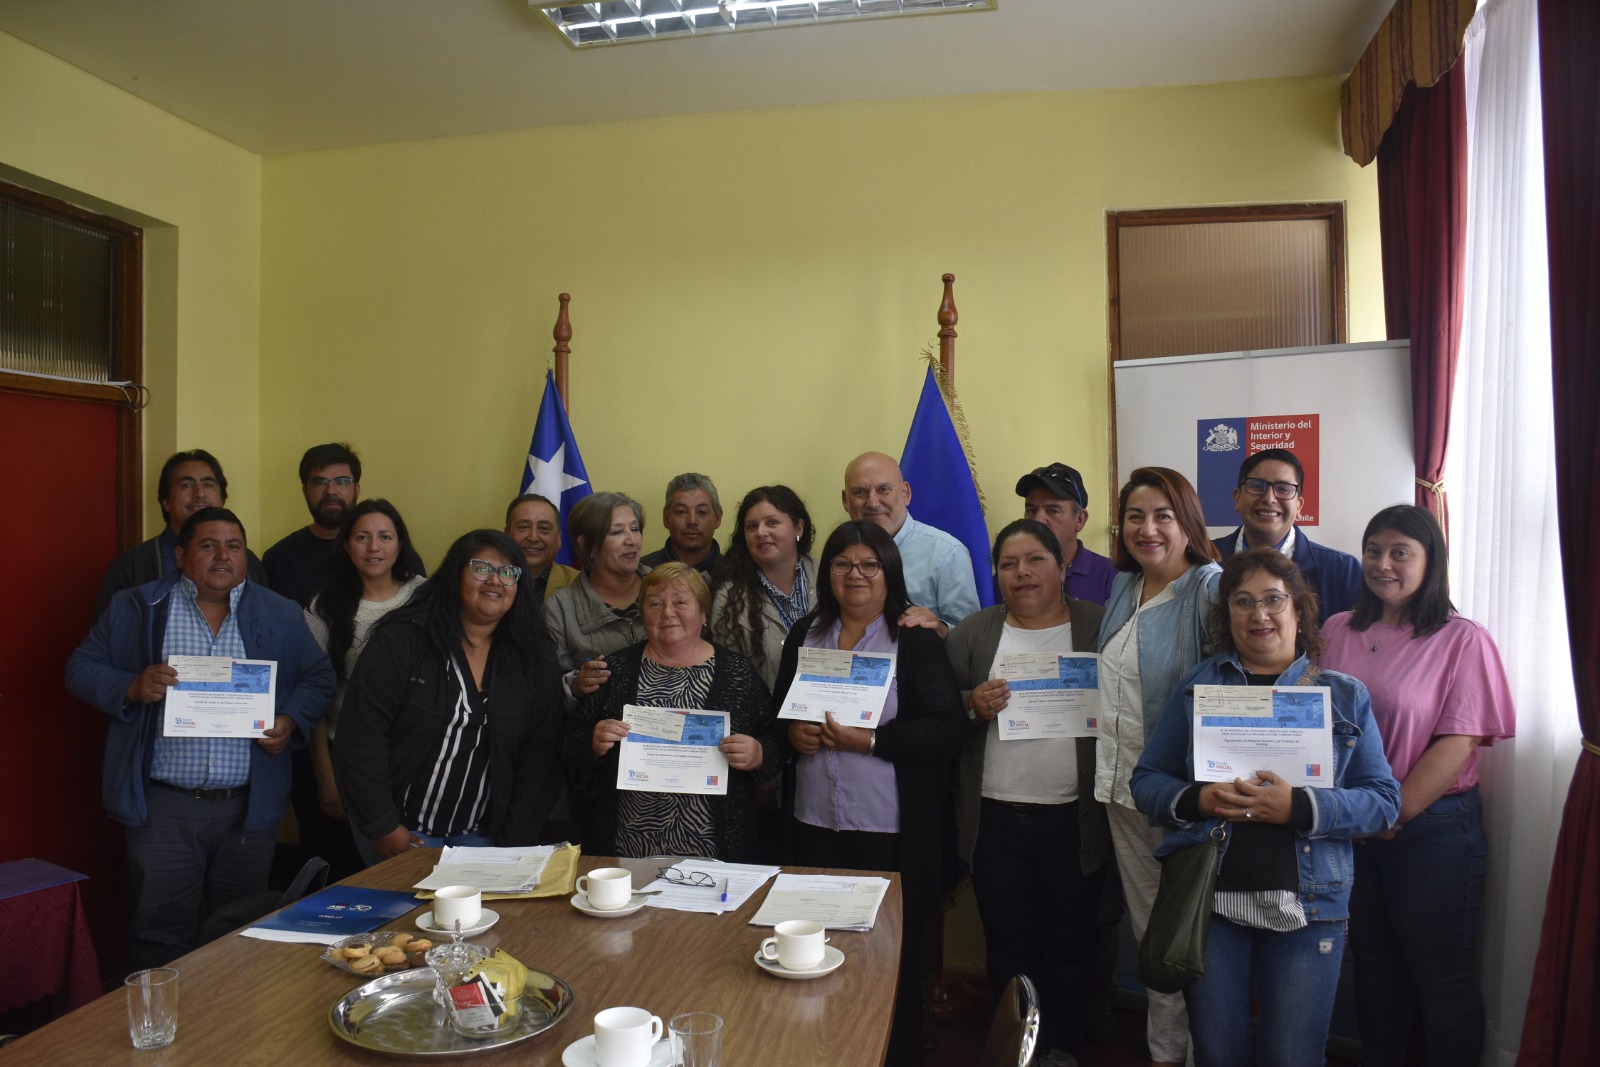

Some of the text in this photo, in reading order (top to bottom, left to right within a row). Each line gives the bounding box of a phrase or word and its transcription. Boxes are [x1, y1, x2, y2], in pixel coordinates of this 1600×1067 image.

[1250, 420, 1312, 430] Ministerio del
[1250, 432, 1291, 441] Interior y
[1250, 441, 1295, 451] Seguridad
